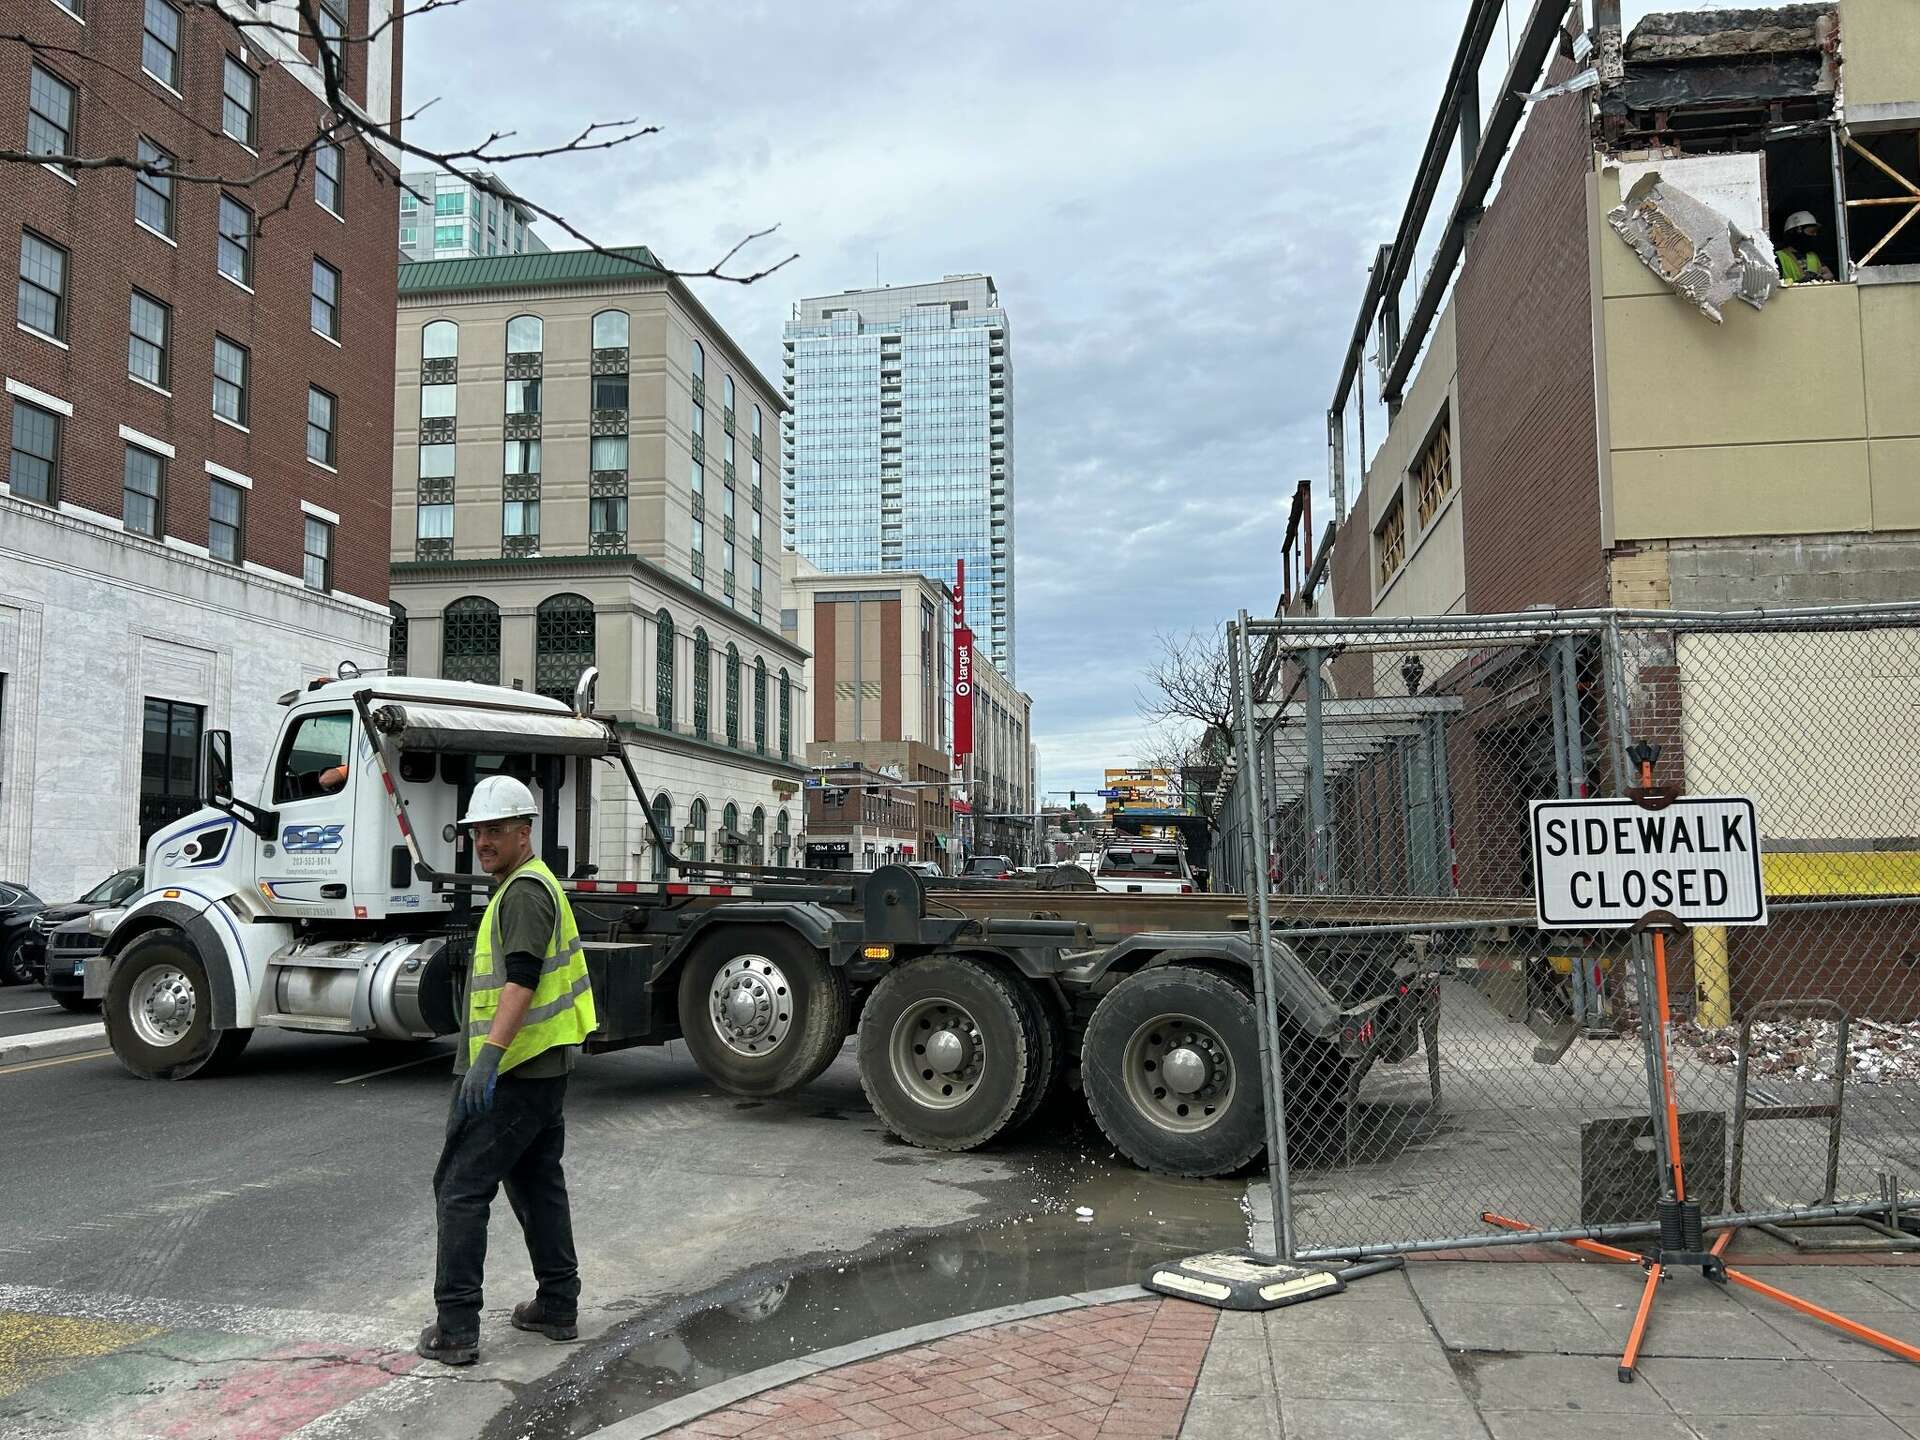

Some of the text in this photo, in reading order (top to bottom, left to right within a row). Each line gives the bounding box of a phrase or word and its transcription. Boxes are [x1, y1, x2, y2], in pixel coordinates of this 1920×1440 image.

[957, 645, 970, 680] target
[1545, 814, 1747, 857] SIDEWALK
[1569, 868, 1728, 909] CLOSED
